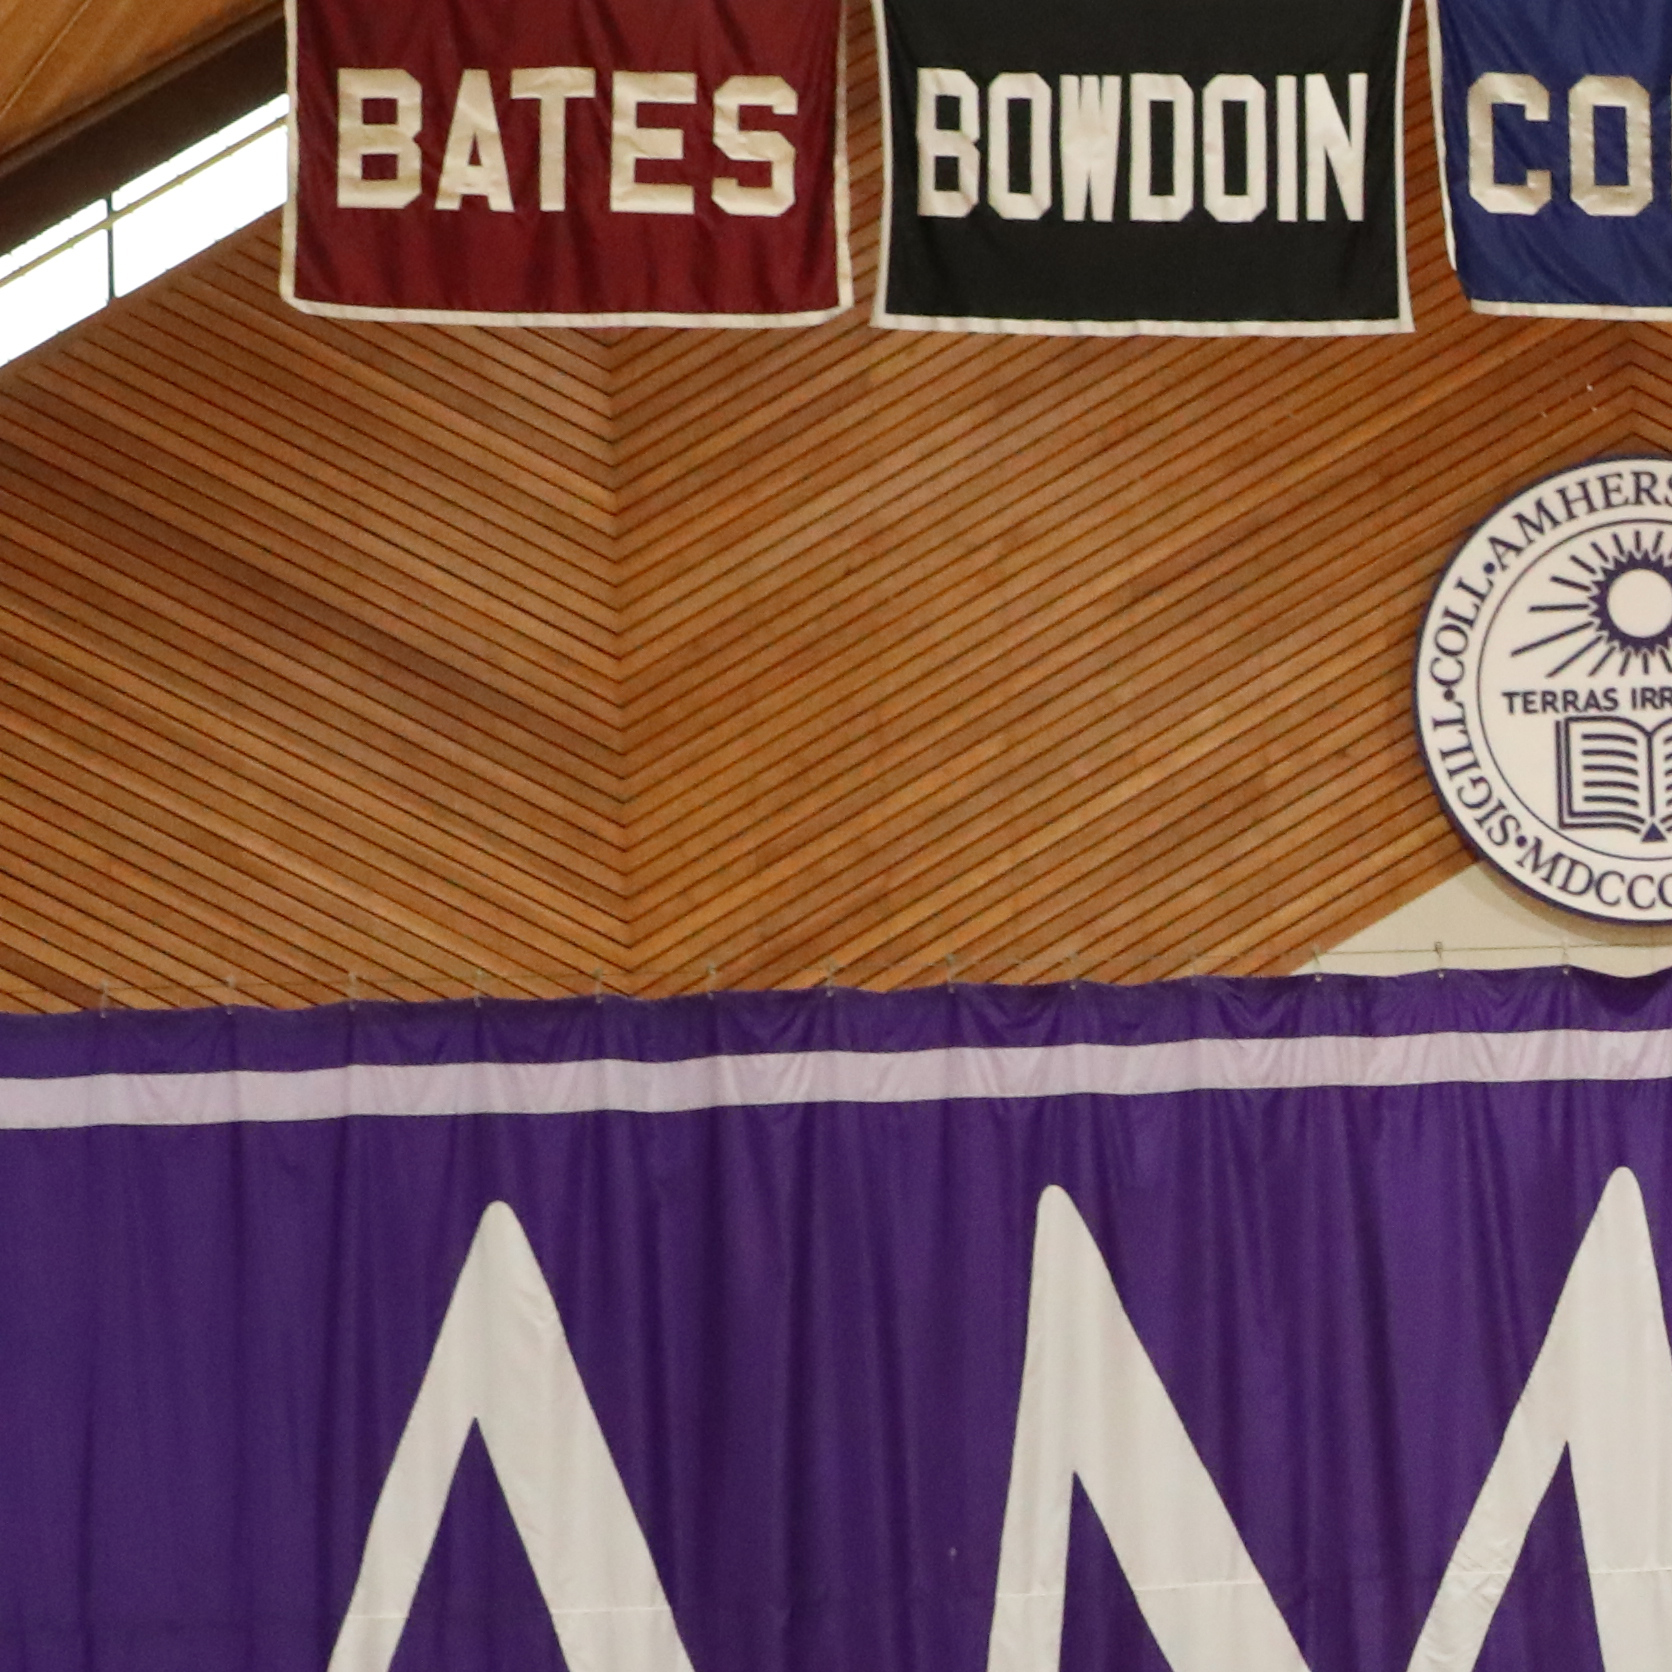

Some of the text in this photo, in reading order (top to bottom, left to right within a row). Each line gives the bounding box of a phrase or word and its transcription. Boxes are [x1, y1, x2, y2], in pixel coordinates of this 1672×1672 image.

[336, 67, 798, 217] BATES
[916, 67, 1367, 222] BOWDOIN
[1501, 688, 1620, 716] TERRAS
